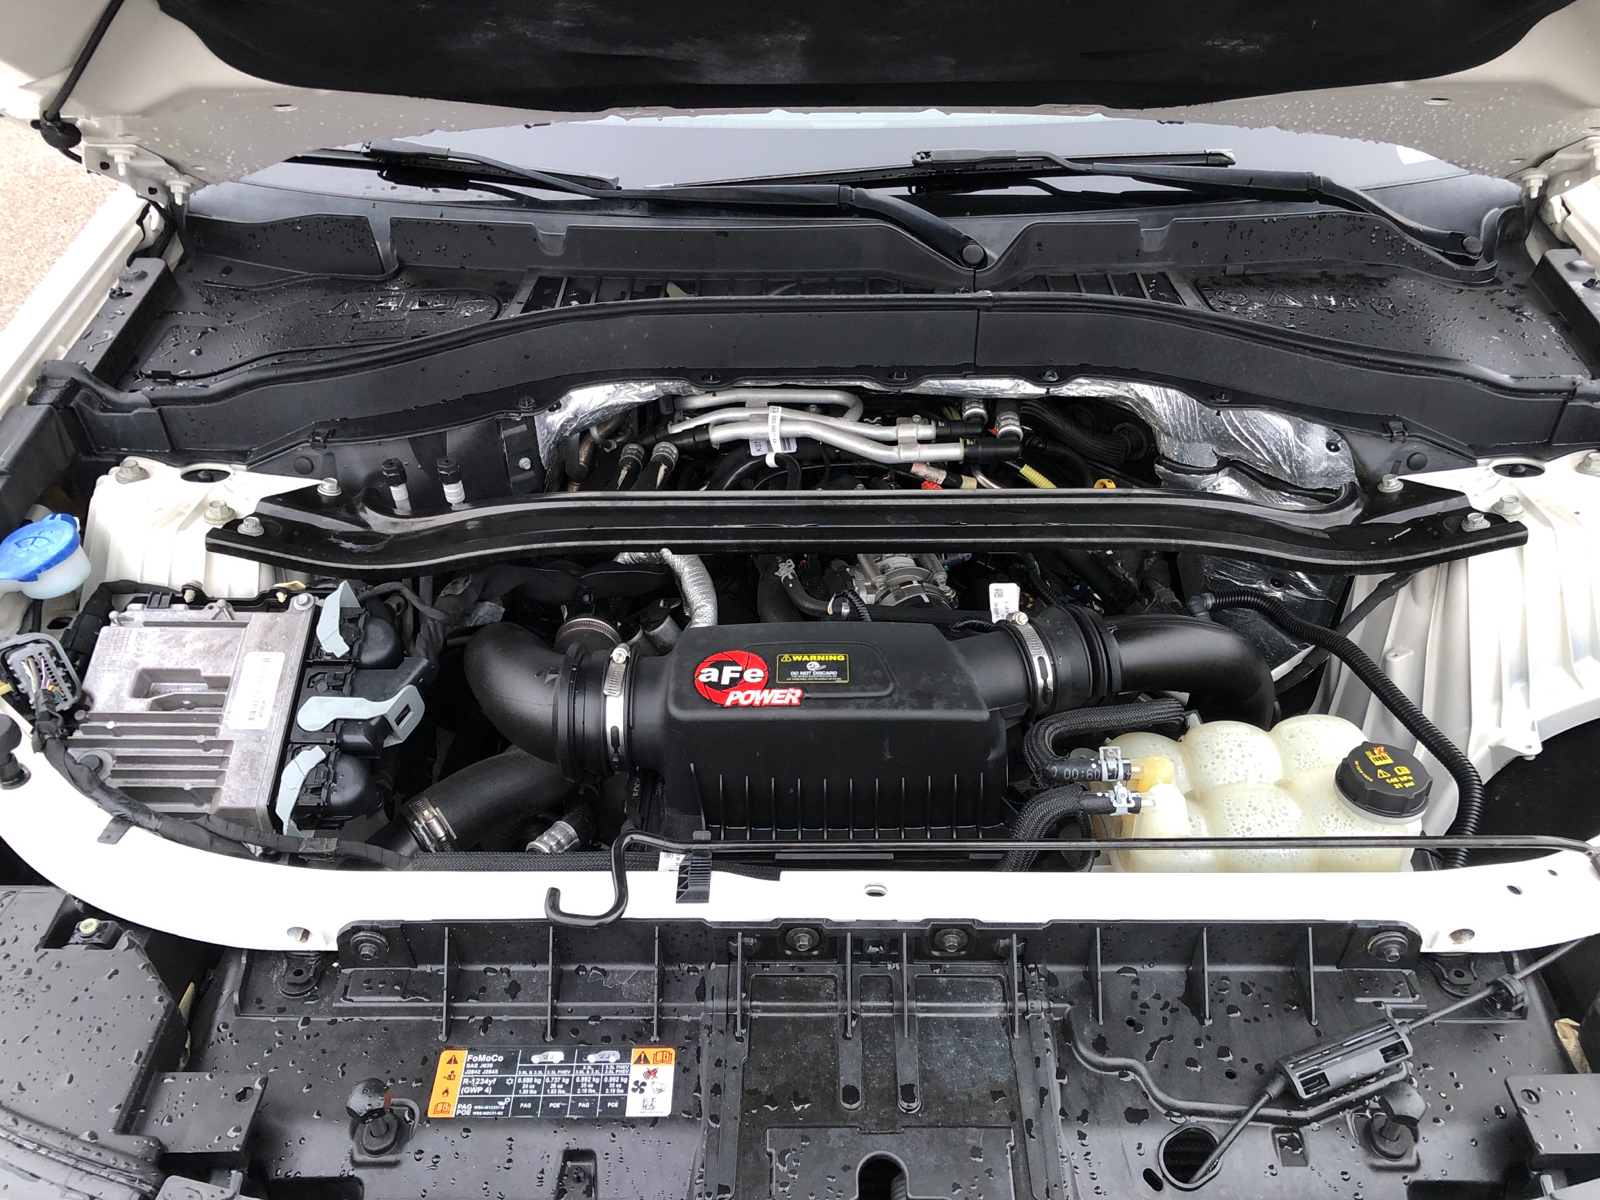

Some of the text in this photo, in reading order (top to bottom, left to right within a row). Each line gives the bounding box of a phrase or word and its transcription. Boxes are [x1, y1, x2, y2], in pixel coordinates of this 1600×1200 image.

[698, 665, 765, 685] aFe
[725, 689, 802, 706] POWER
[467, 1054, 504, 1062] FoMoCo
[462, 1078, 497, 1087] R-1234yf
[561, 1077, 570, 1085] kg
[592, 1076, 600, 1084] kg
[620, 1076, 628, 1084] kg
[460, 1086, 492, 1095] (GWP 4)
